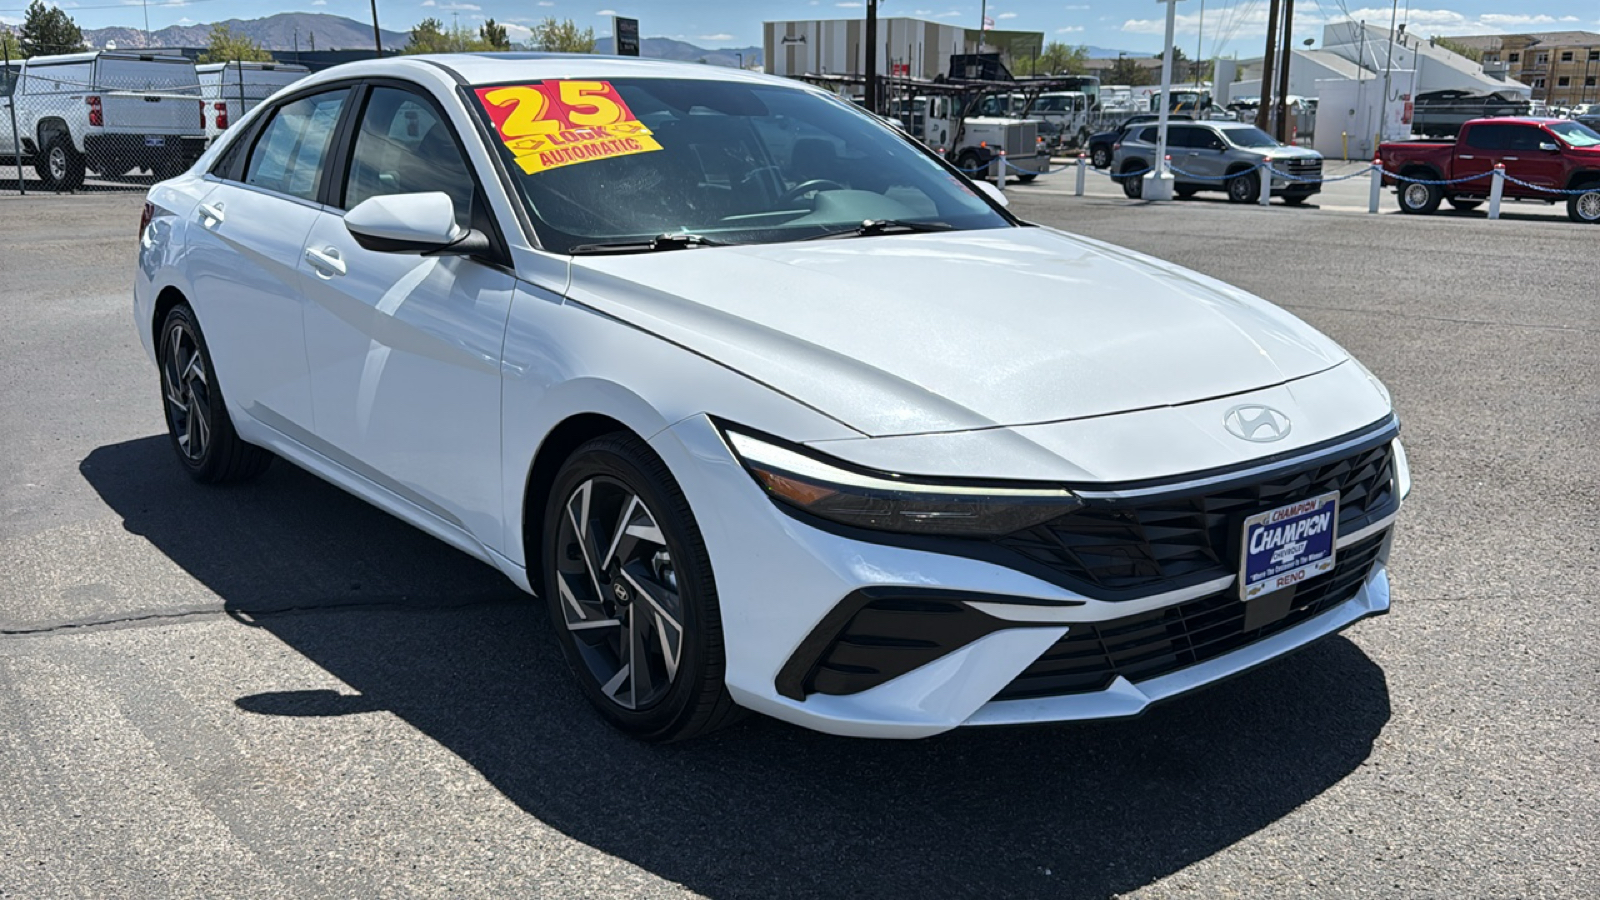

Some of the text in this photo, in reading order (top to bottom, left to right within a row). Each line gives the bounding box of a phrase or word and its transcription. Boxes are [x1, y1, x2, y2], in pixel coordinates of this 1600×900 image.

[484, 81, 626, 138] 25
[545, 125, 613, 146] LOOK
[539, 137, 643, 167] AUTOMATIC
[1272, 499, 1317, 522] CHAMPION
[1249, 512, 1331, 555] CHAMPION
[1276, 569, 1306, 587] RENO
